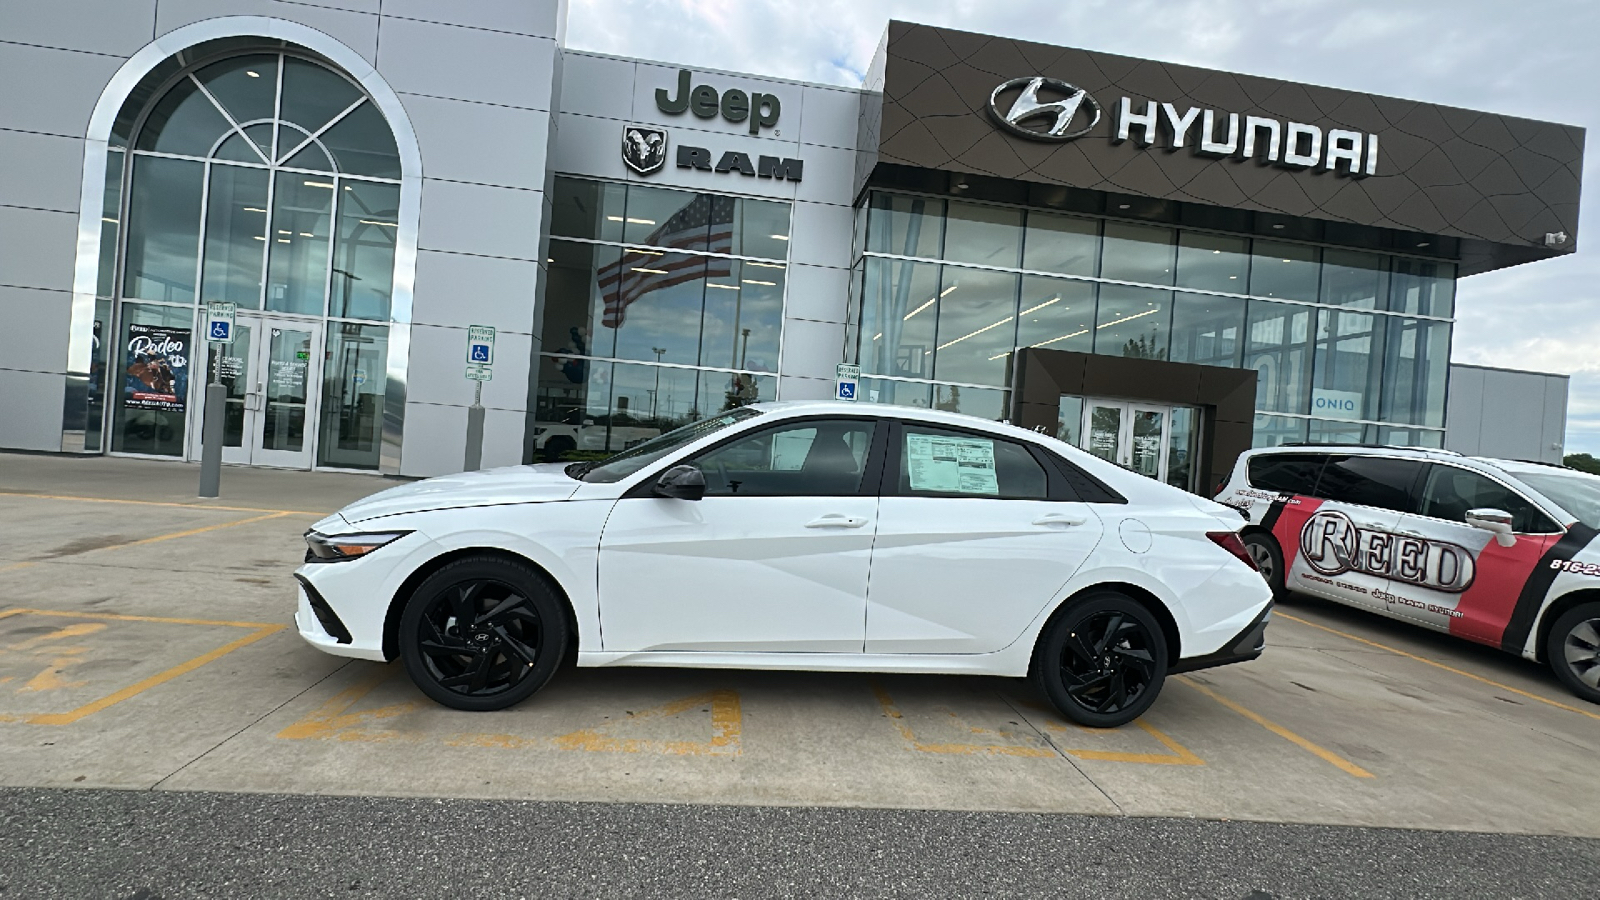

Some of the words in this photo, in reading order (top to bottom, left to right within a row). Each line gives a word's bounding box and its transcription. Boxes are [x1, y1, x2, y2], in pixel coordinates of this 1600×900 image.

[655, 69, 781, 135] Jeep
[1116, 96, 1379, 177] HYUNDAI
[677, 145, 804, 182] RAM
[128, 335, 184, 358] Rodeo
[1311, 396, 1354, 411] ONIQ
[1300, 510, 1477, 593] REED
